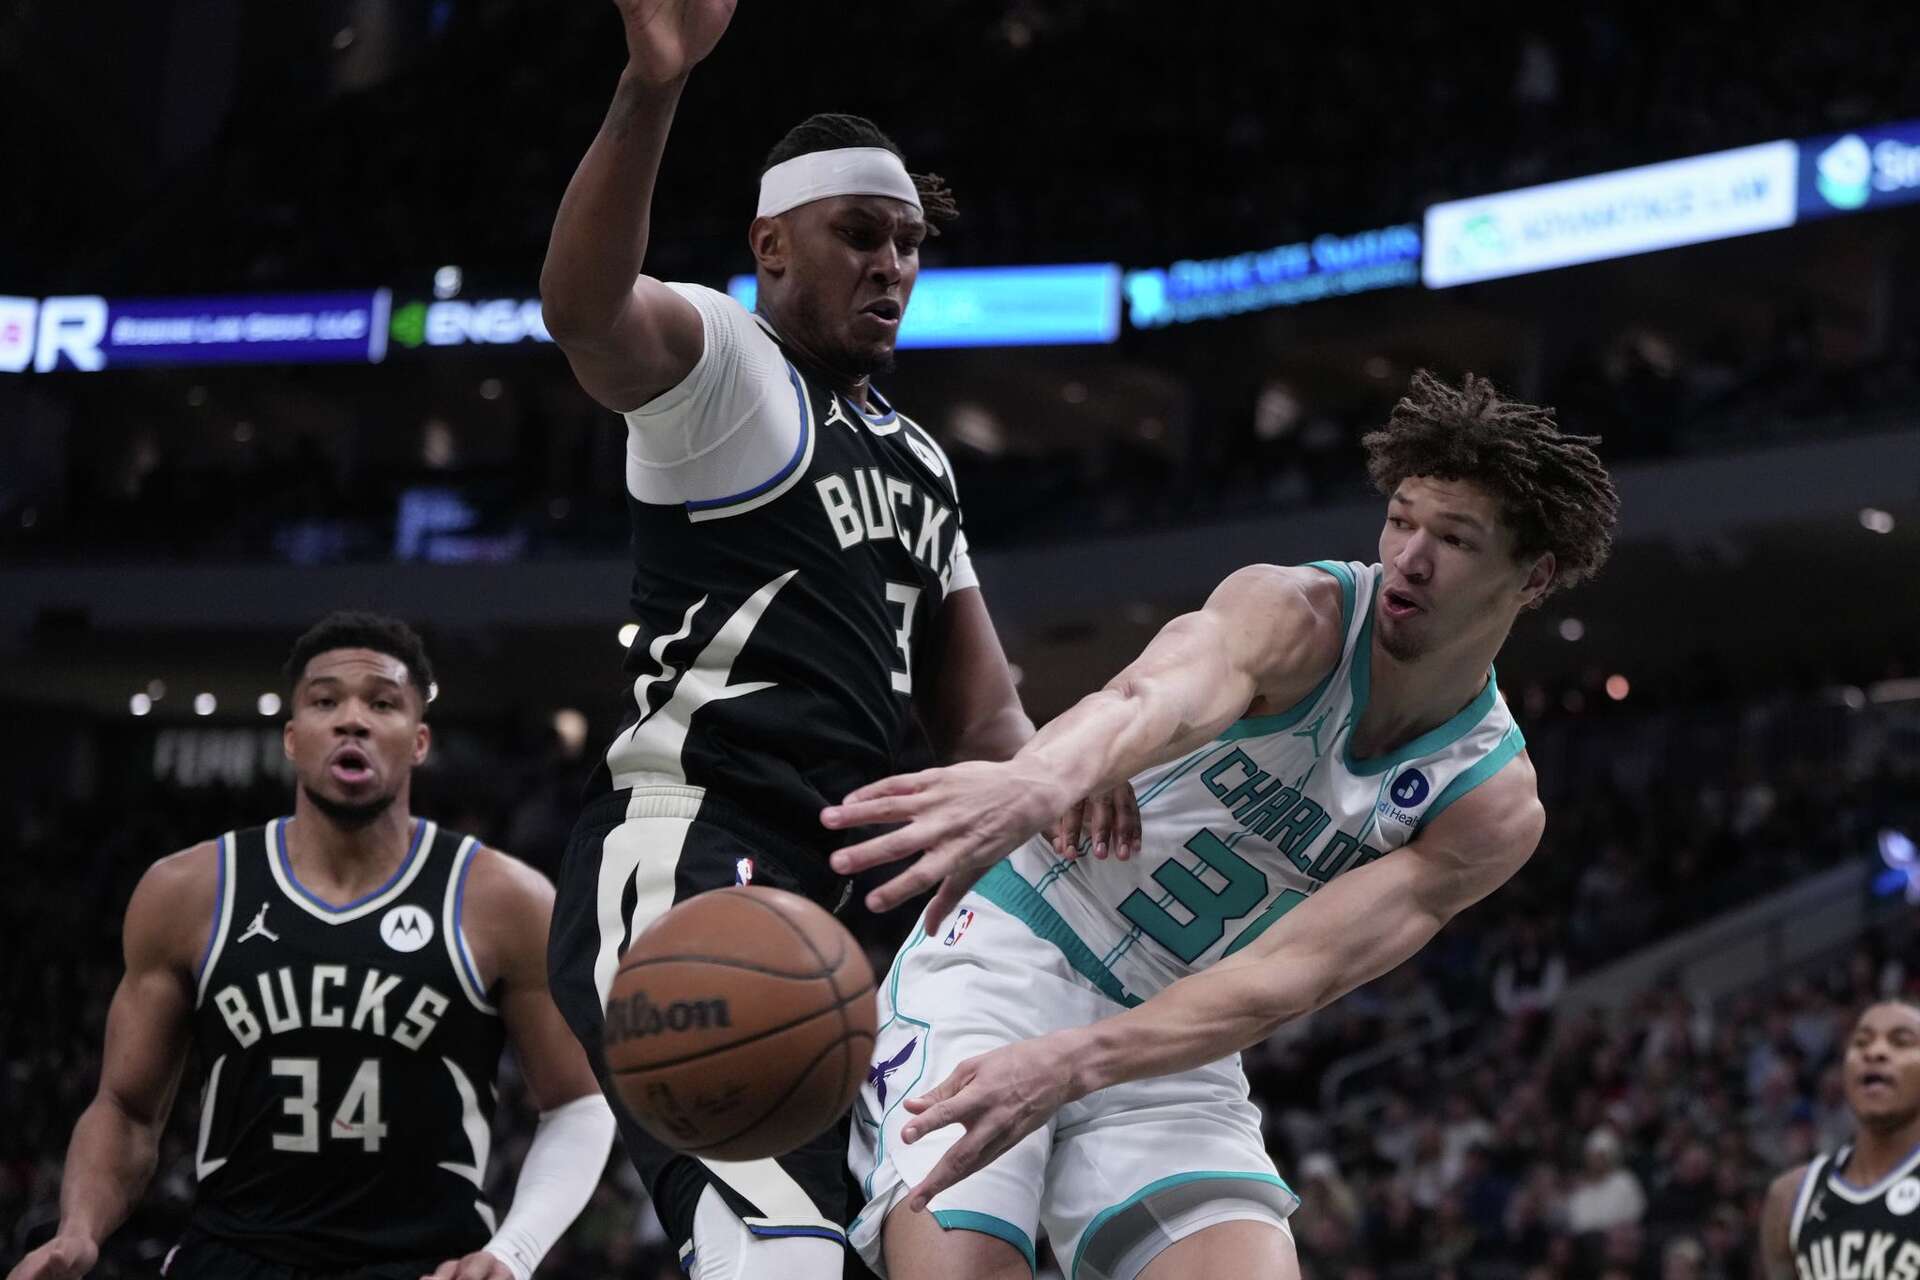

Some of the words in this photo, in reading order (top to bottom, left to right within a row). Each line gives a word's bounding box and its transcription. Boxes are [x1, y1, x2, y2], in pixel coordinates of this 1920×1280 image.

[1389, 807, 1421, 828] Heal
[213, 964, 450, 1051] BUCKS
[271, 1057, 388, 1153] 34
